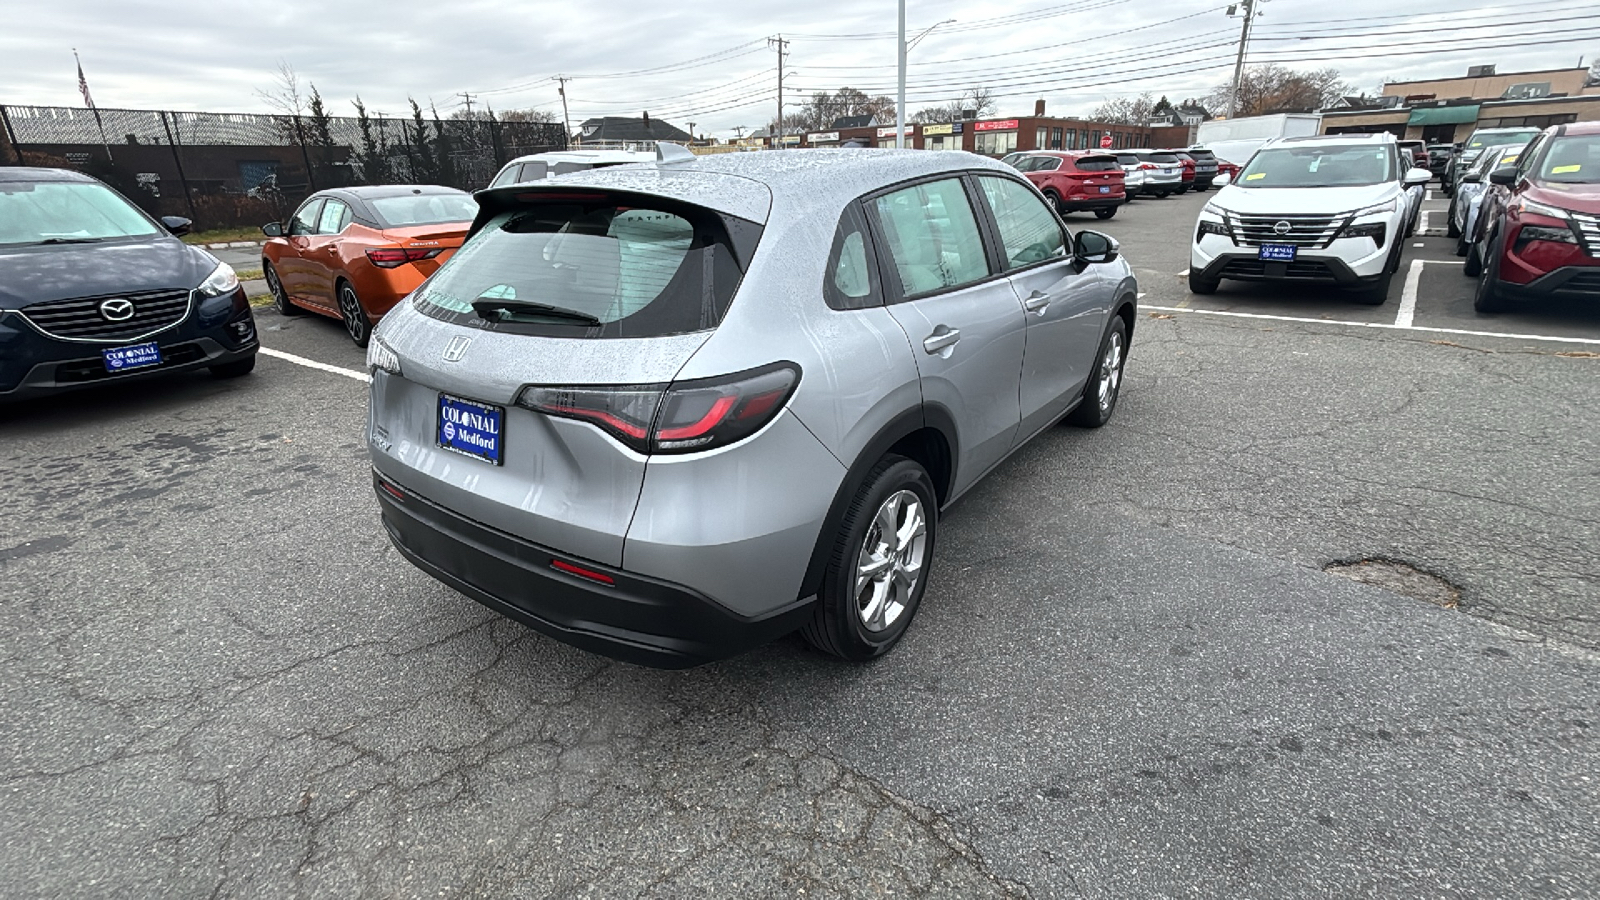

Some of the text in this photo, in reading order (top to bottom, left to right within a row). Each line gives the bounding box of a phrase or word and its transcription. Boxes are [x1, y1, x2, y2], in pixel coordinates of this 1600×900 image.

[106, 347, 158, 361] COLONIAL
[126, 354, 157, 364] Medford
[442, 406, 499, 435] COLONIAL
[458, 428, 495, 450] Medford
